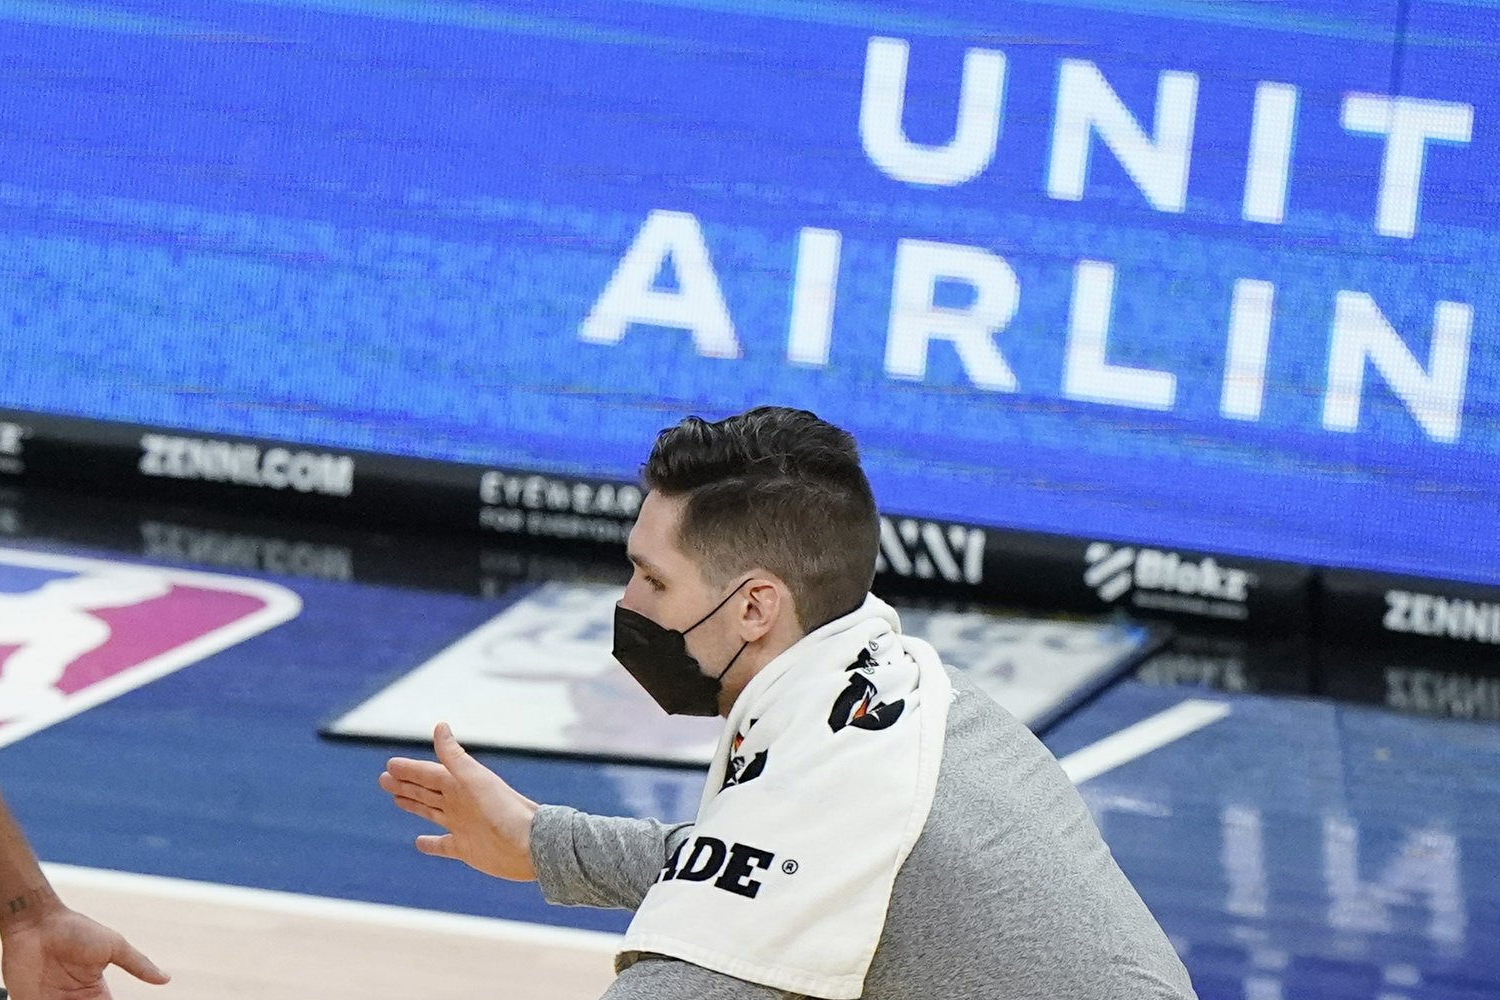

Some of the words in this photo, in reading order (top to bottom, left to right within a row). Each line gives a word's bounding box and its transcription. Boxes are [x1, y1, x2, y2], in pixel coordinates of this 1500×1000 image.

[858, 35, 1474, 238] UNIT
[578, 209, 1474, 444] AIRLIN
[139, 434, 355, 496] ZENNI.COM
[1135, 549, 1248, 601] Blokz
